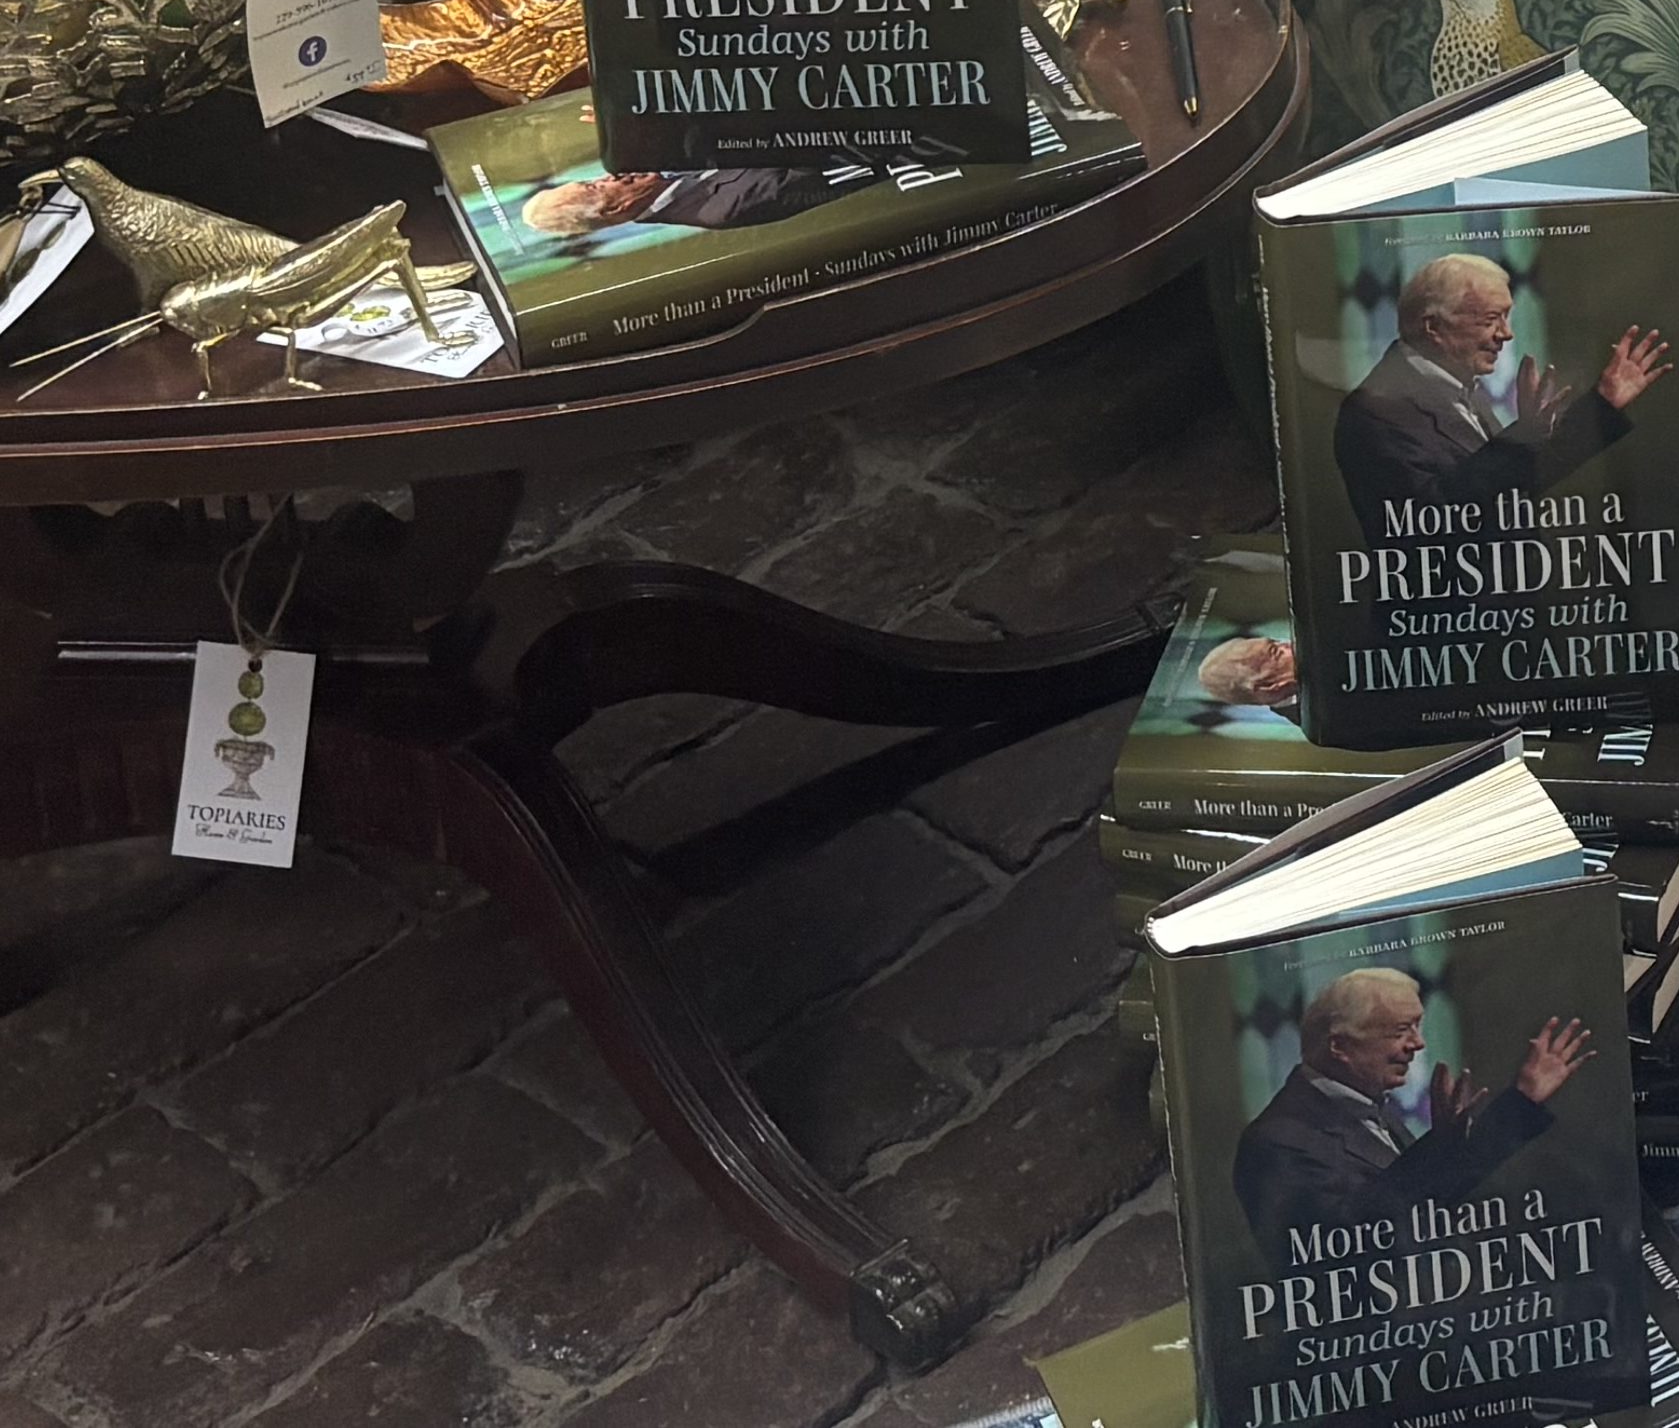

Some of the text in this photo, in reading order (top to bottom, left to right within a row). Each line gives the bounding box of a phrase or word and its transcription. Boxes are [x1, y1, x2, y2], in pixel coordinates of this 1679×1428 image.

[678, 20, 930, 60] Sundays with
[631, 60, 992, 115] JIMMY CARTER
[717, 129, 913, 150] Edited by ANDREW GREER
[1445, 231, 1500, 241] BARBARA
[1549, 225, 1591, 235] TAYLOR
[613, 309, 659, 336] More
[664, 300, 706, 322] than
[712, 295, 722, 309] a
[726, 268, 809, 305] President
[825, 247, 895, 276] Sundays
[900, 234, 938, 257] with
[943, 220, 999, 245] Jimmy
[1005, 203, 1058, 228] Carter
[1384, 488, 1625, 538] More than a
[1336, 529, 1675, 604] PRESIDENT
[1389, 594, 1629, 637] Sundays with
[1341, 643, 1485, 692] JIMMY
[1421, 696, 1608, 722] Edited by ANDREW GREER
[188, 804, 286, 830] TOPIARIES
[1194, 799, 1236, 816] More
[1240, 800, 1279, 817] than
[1283, 804, 1292, 817] a
[1563, 811, 1613, 828] Carter
[1173, 853, 1212, 873] More
[1349, 941, 1407, 958] BARBARA
[1459, 921, 1505, 937] TAYLOR
[1289, 1189, 1548, 1266] More than a
[1238, 1218, 1602, 1340] PRESIDENT
[1296, 1291, 1555, 1367] Sundays with
[1246, 1319, 1615, 1428] JIMMY CARTER
[1474, 1396, 1533, 1418] GREER
